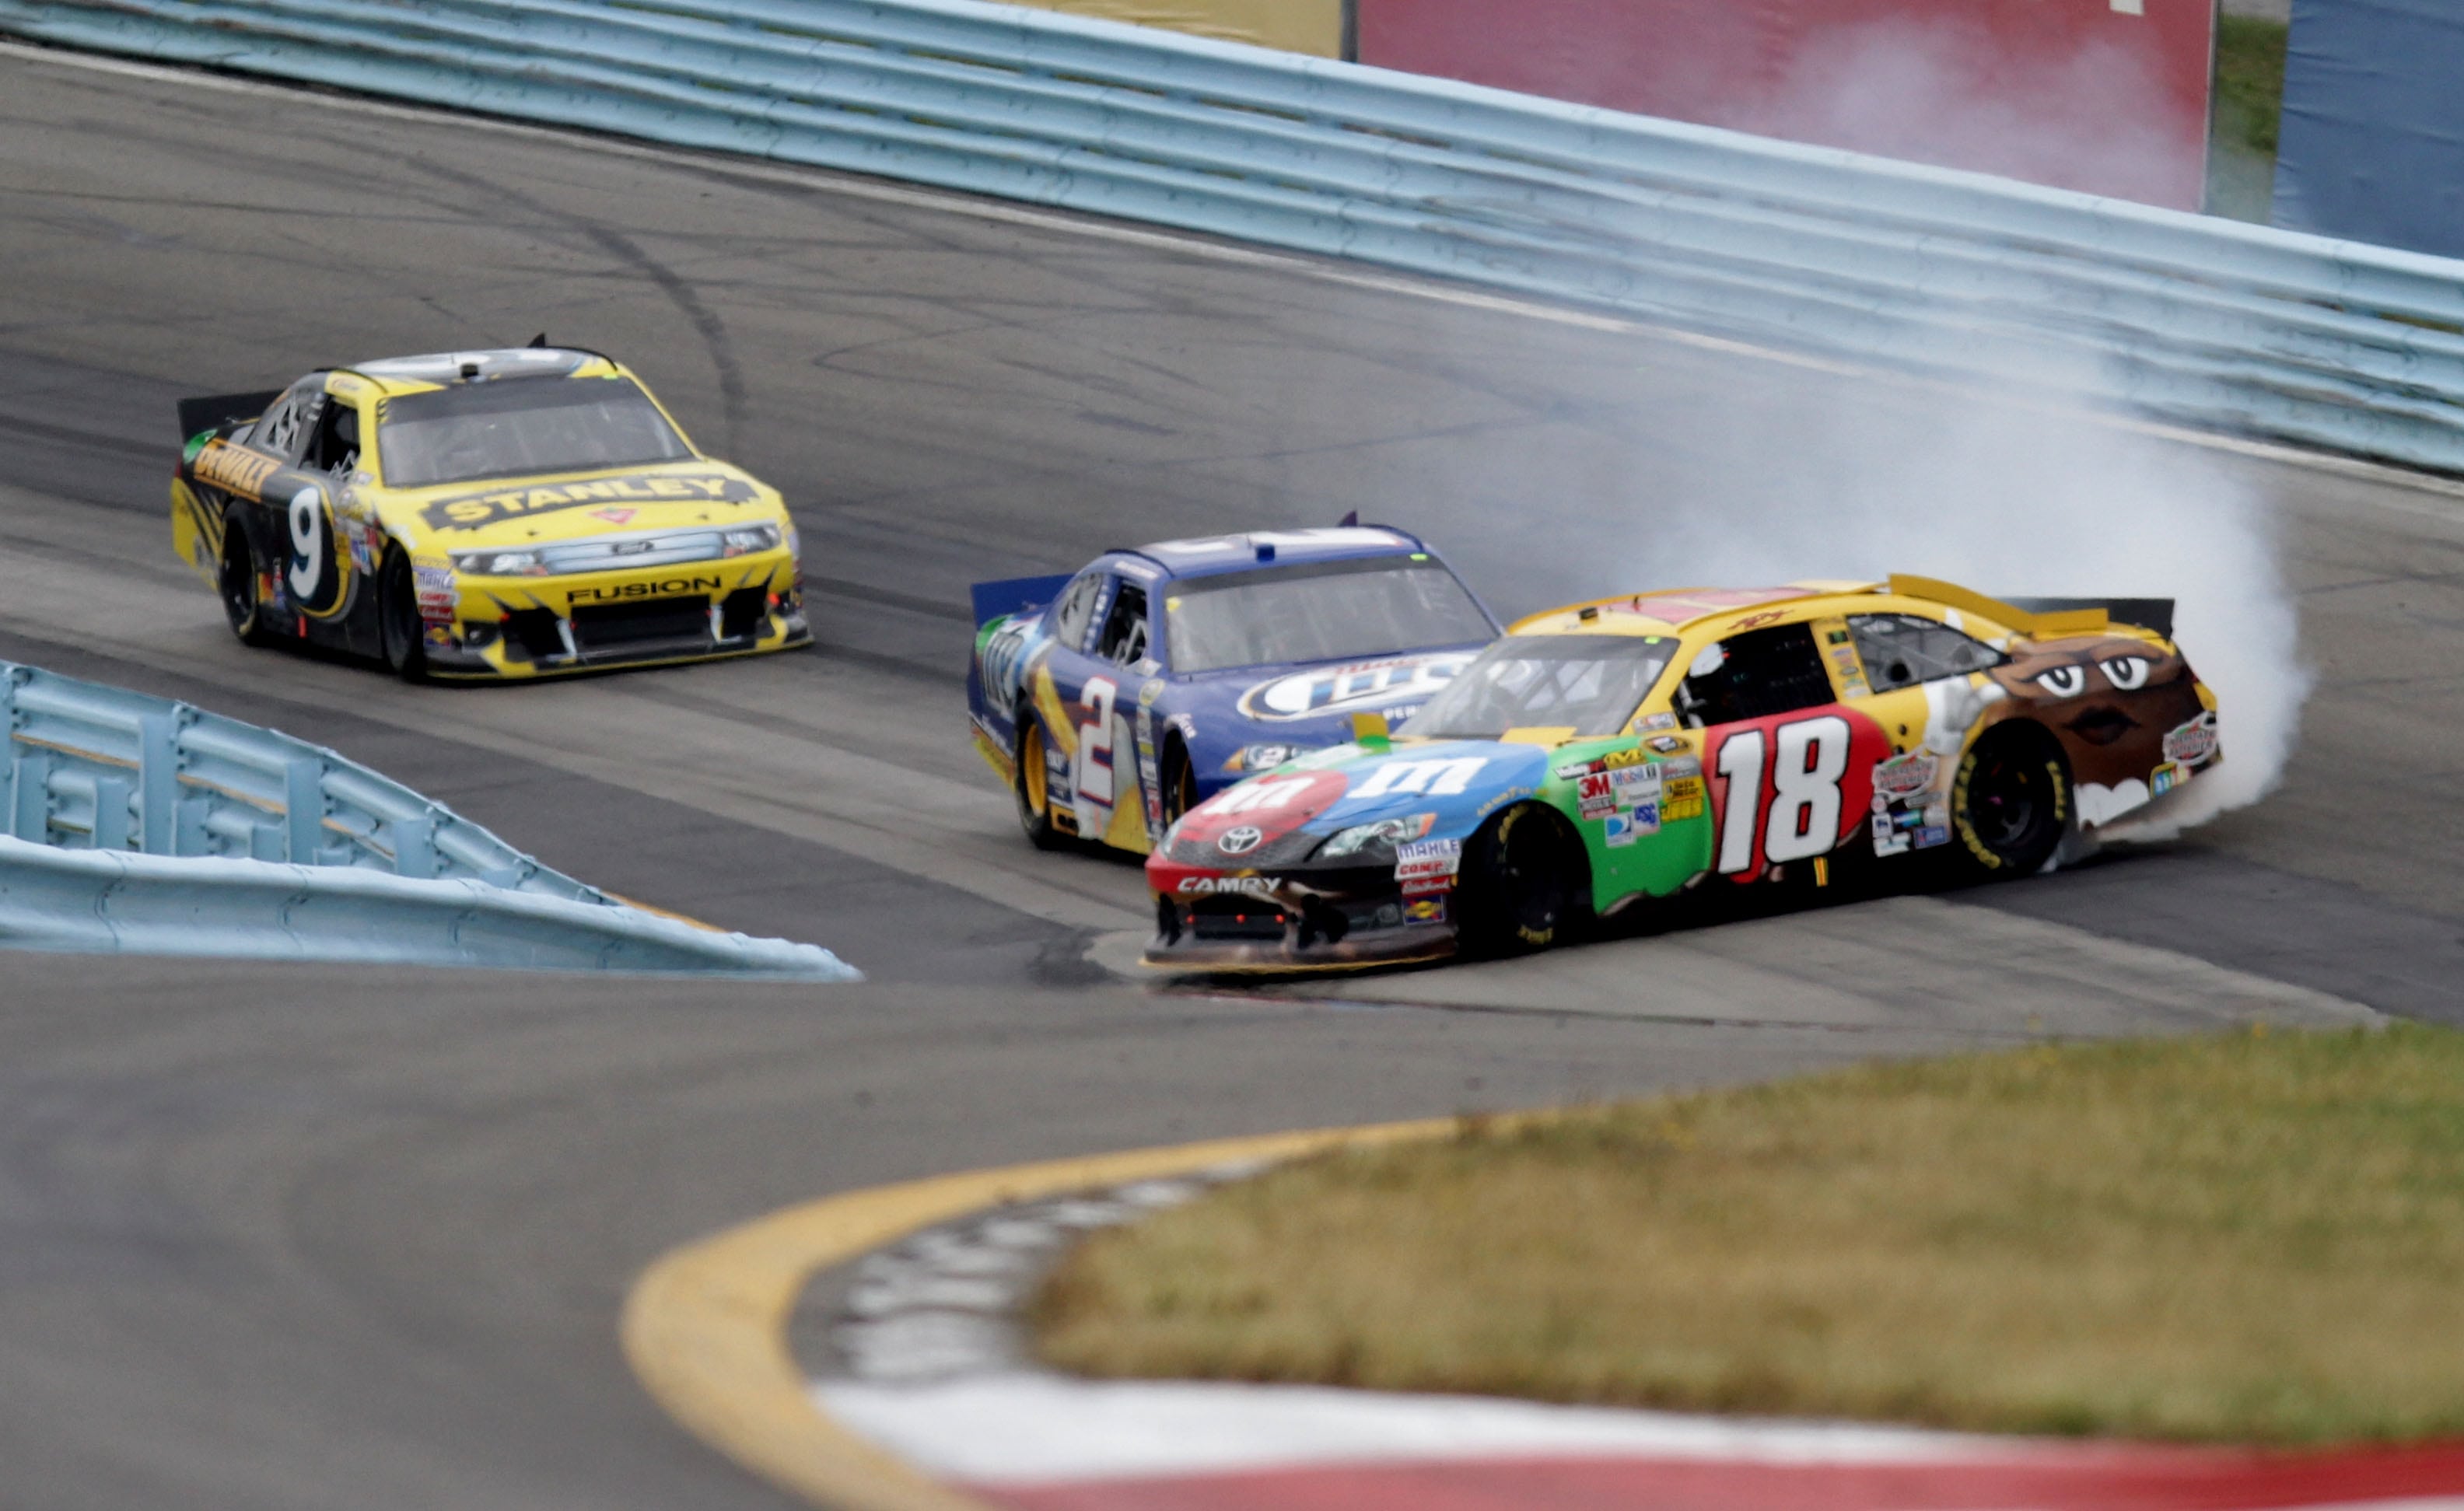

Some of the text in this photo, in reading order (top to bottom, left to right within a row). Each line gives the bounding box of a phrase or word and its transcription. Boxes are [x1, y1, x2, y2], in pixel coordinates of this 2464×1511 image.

[444, 478, 725, 523] STANLEY
[288, 486, 323, 599] 9
[567, 575, 722, 603] FUSION
[1079, 674, 1118, 810] 2
[1579, 773, 1611, 799] 3M
[1717, 715, 1851, 875] 18
[1399, 839, 1459, 859] MAHLE
[1178, 876, 1282, 893] CAMRY
